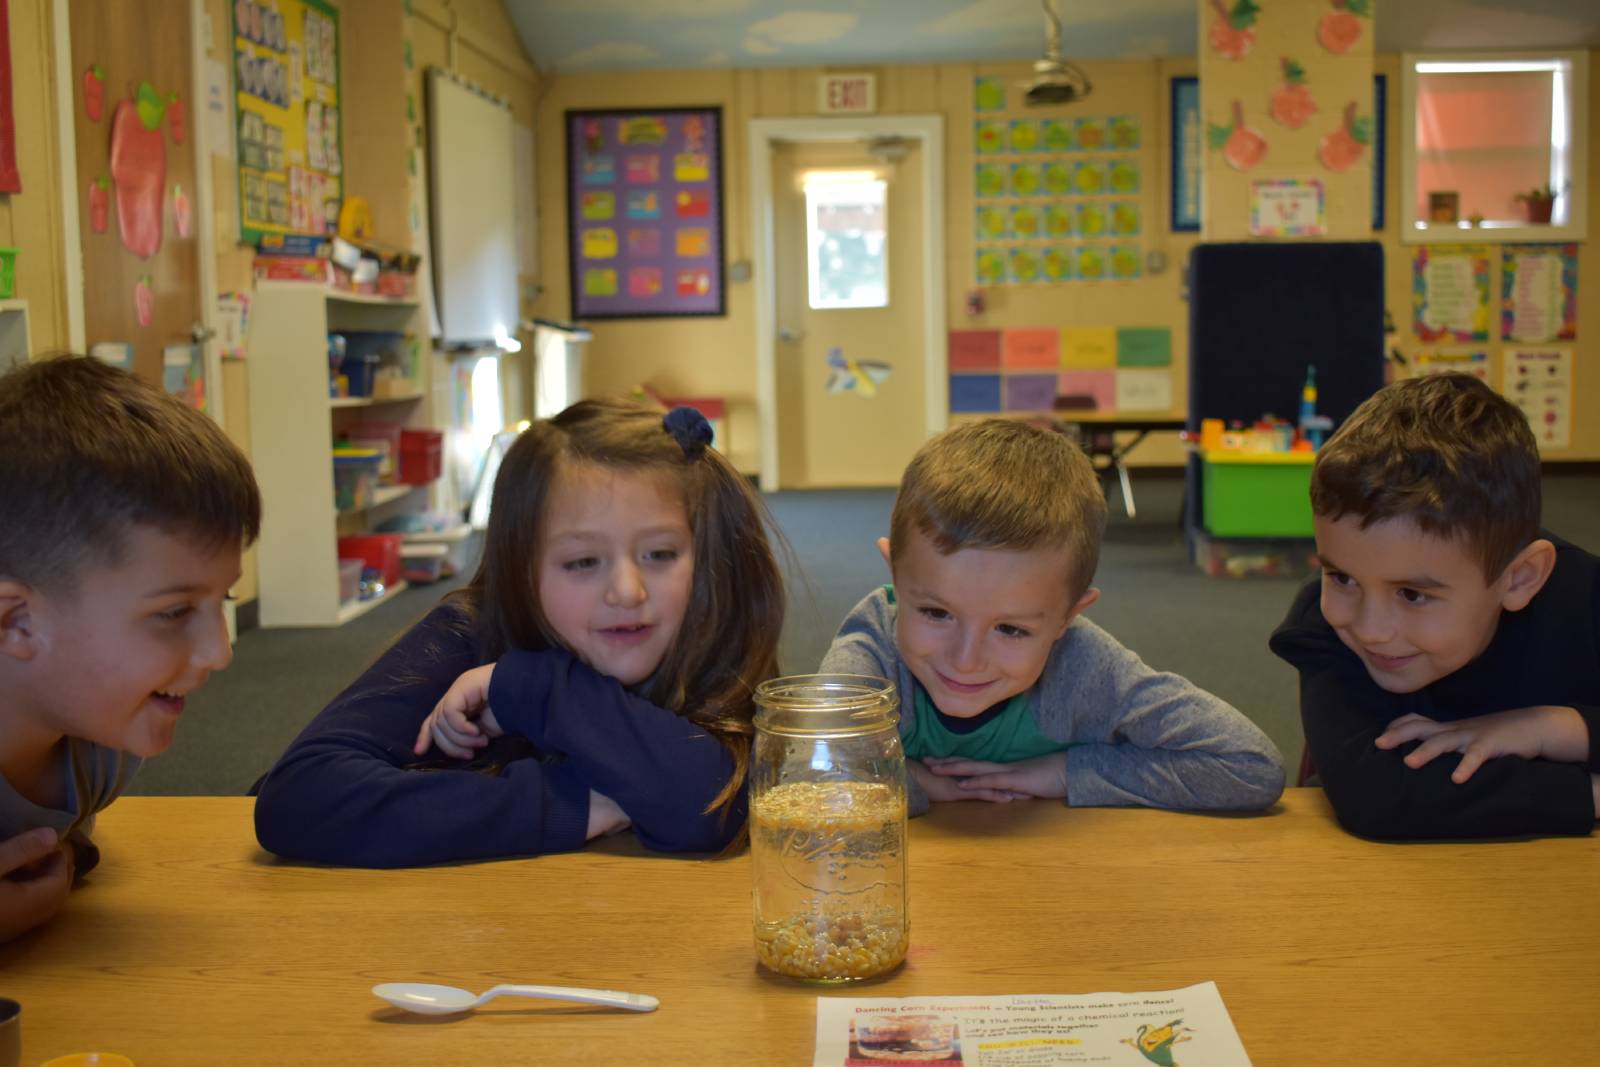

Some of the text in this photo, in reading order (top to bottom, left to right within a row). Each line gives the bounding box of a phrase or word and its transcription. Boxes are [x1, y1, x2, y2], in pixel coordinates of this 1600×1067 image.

[828, 80, 867, 109] EXIT
[855, 1006, 897, 1014] Dancing
[1078, 1011, 1129, 1020] chemical
